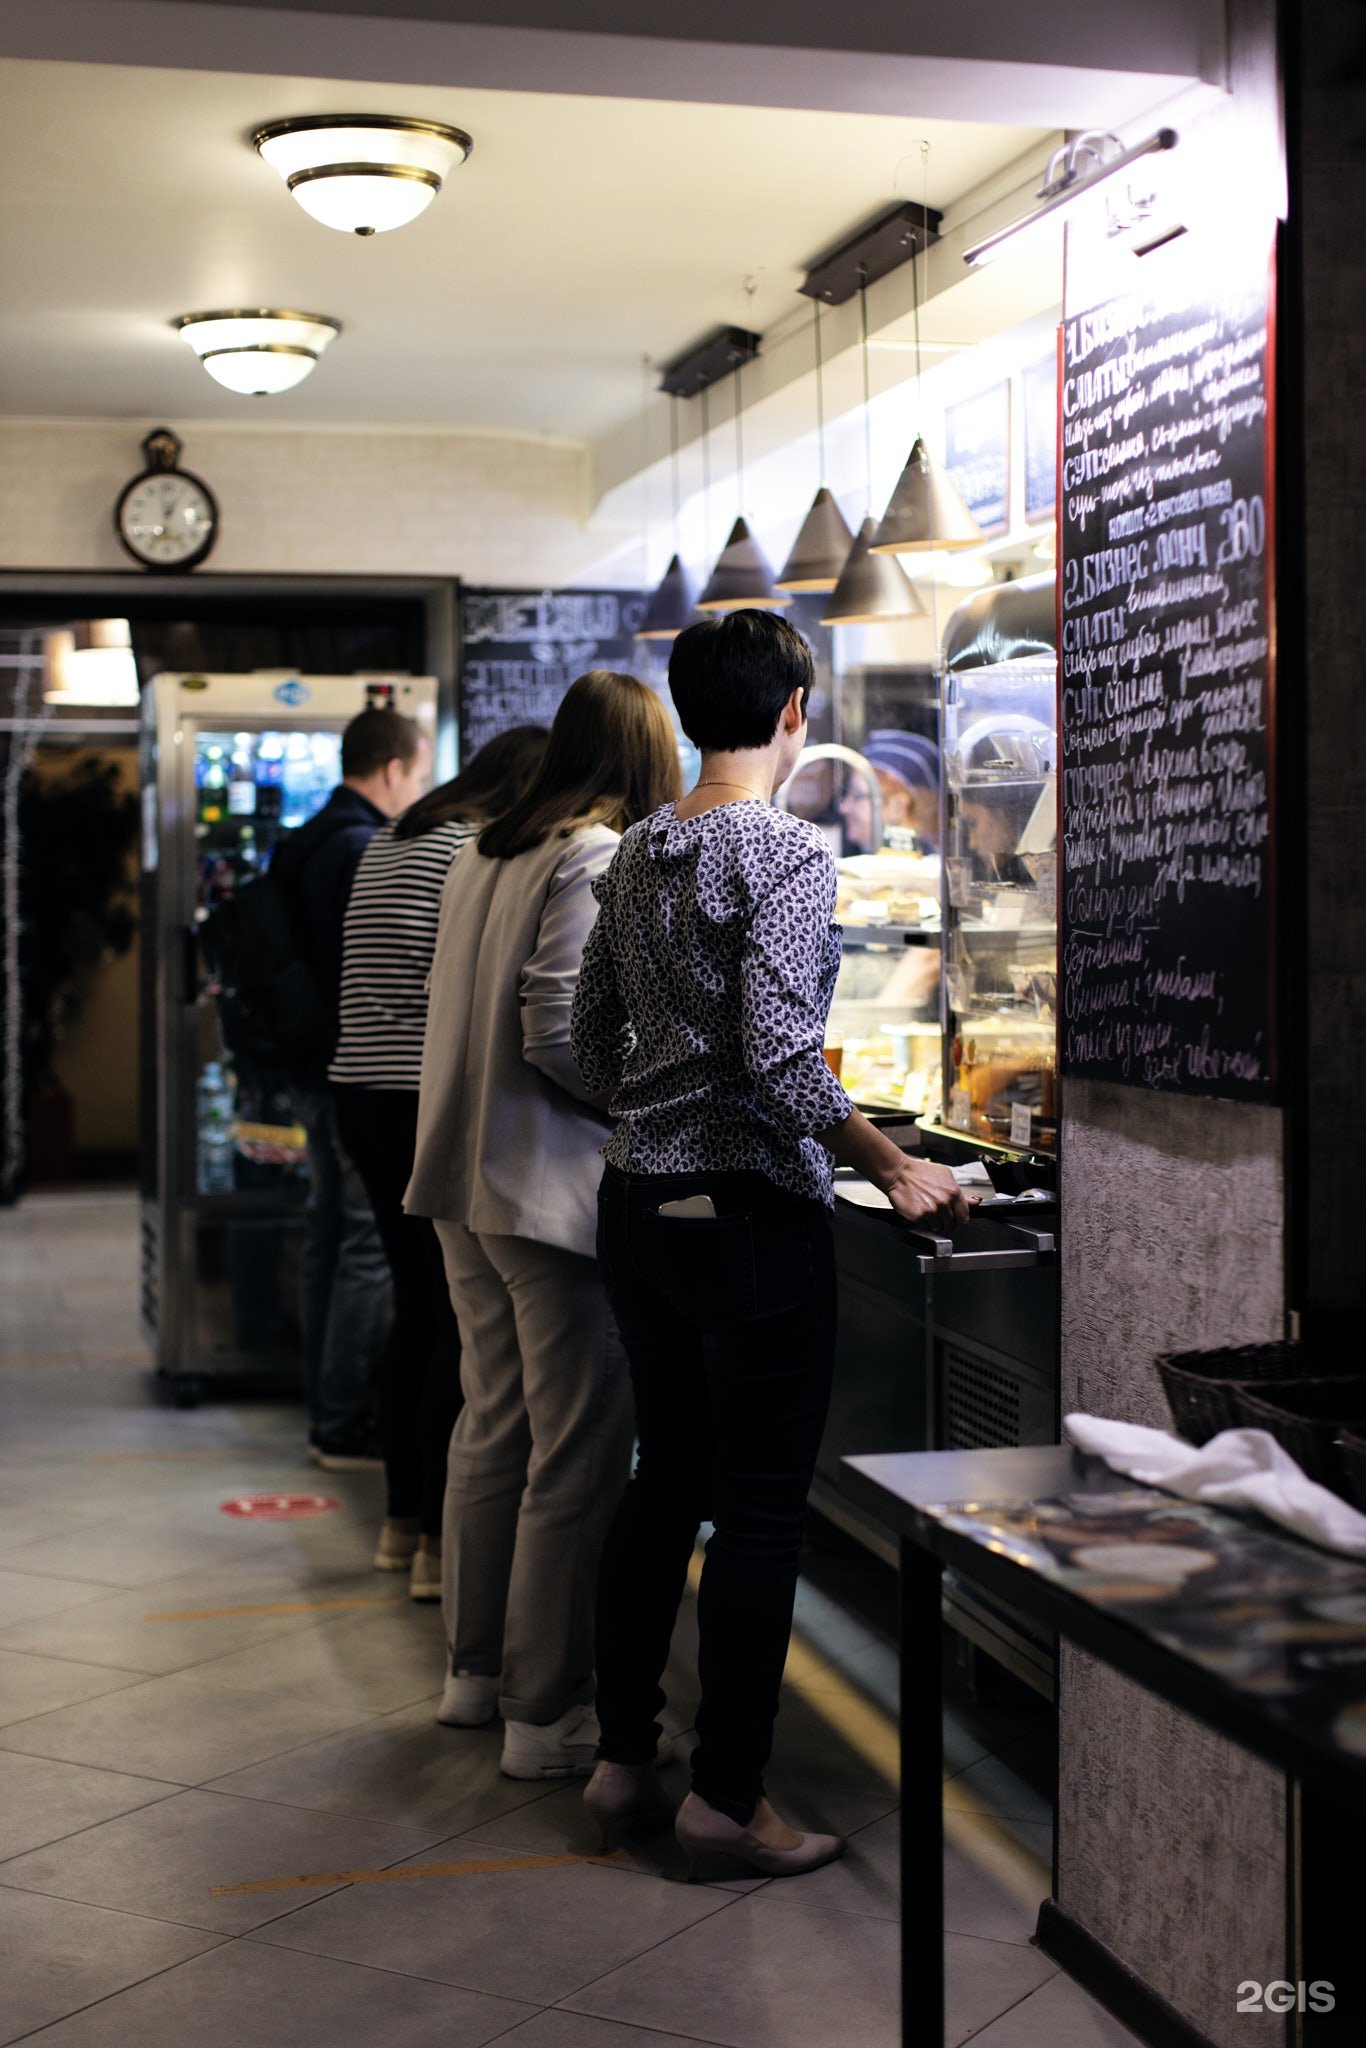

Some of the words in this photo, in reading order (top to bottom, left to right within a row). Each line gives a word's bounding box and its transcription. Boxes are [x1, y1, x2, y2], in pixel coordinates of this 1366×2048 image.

[1131, 465, 1154, 500] из
[1097, 643, 1119, 685] под
[1114, 1021, 1132, 1076] из
